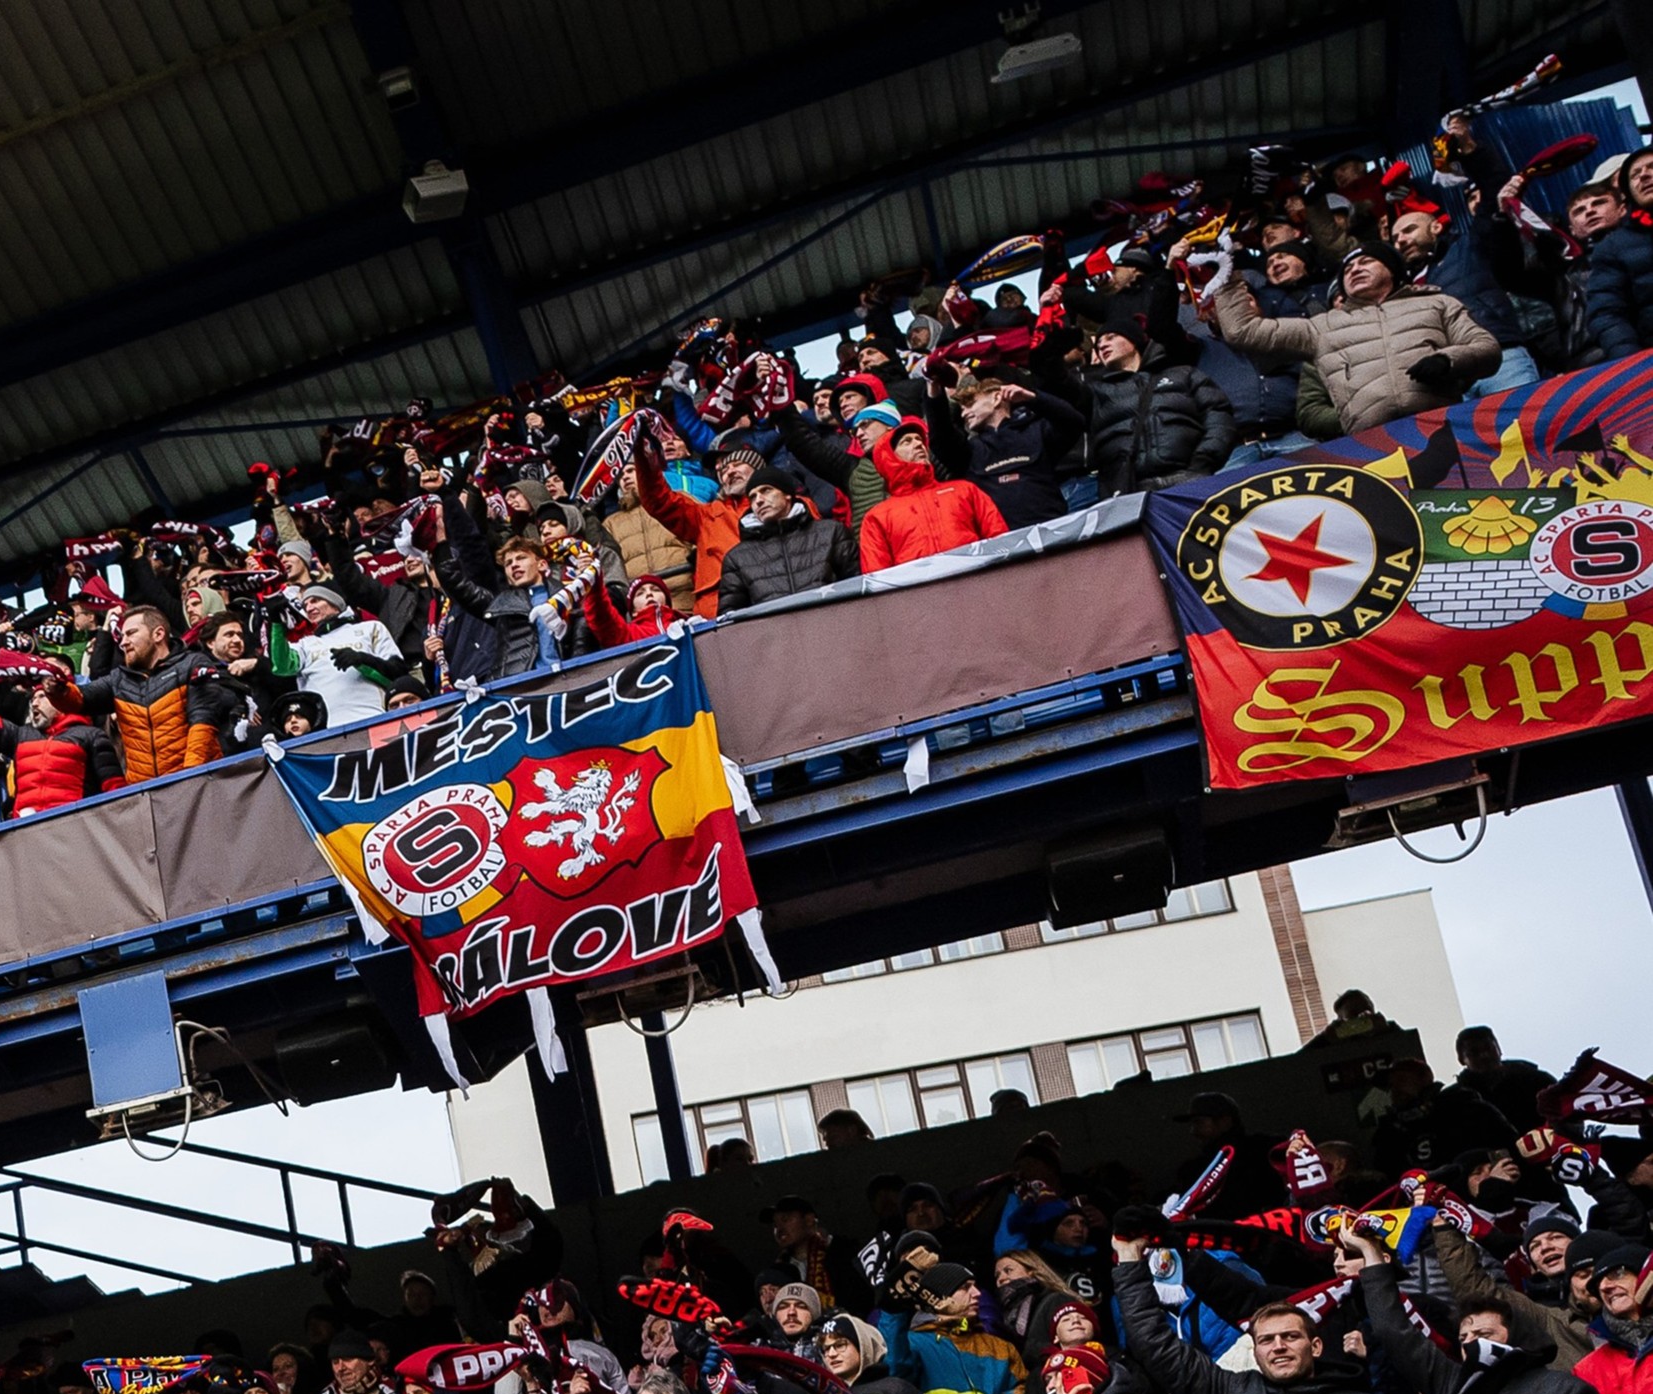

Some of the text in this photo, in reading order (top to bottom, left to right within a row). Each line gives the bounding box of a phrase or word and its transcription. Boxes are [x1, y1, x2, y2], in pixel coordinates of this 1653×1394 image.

[1416, 500, 1469, 515] Praha
[1520, 496, 1557, 515] 13
[1188, 471, 1414, 644] AC SPARTA PRAHA
[1534, 503, 1623, 575] AC SPARTA
[1572, 520, 1641, 577] S
[1564, 579, 1649, 601] FOTBAL
[1233, 621, 1653, 773] Supp
[366, 789, 503, 906] AC SPARTA PRAHA
[396, 811, 480, 885] S
[430, 857, 504, 912] FOTBAL
[432, 842, 723, 1010] RÁLOVÉ
[1558, 1157, 1584, 1181] S
[1076, 1277, 1094, 1297] S
